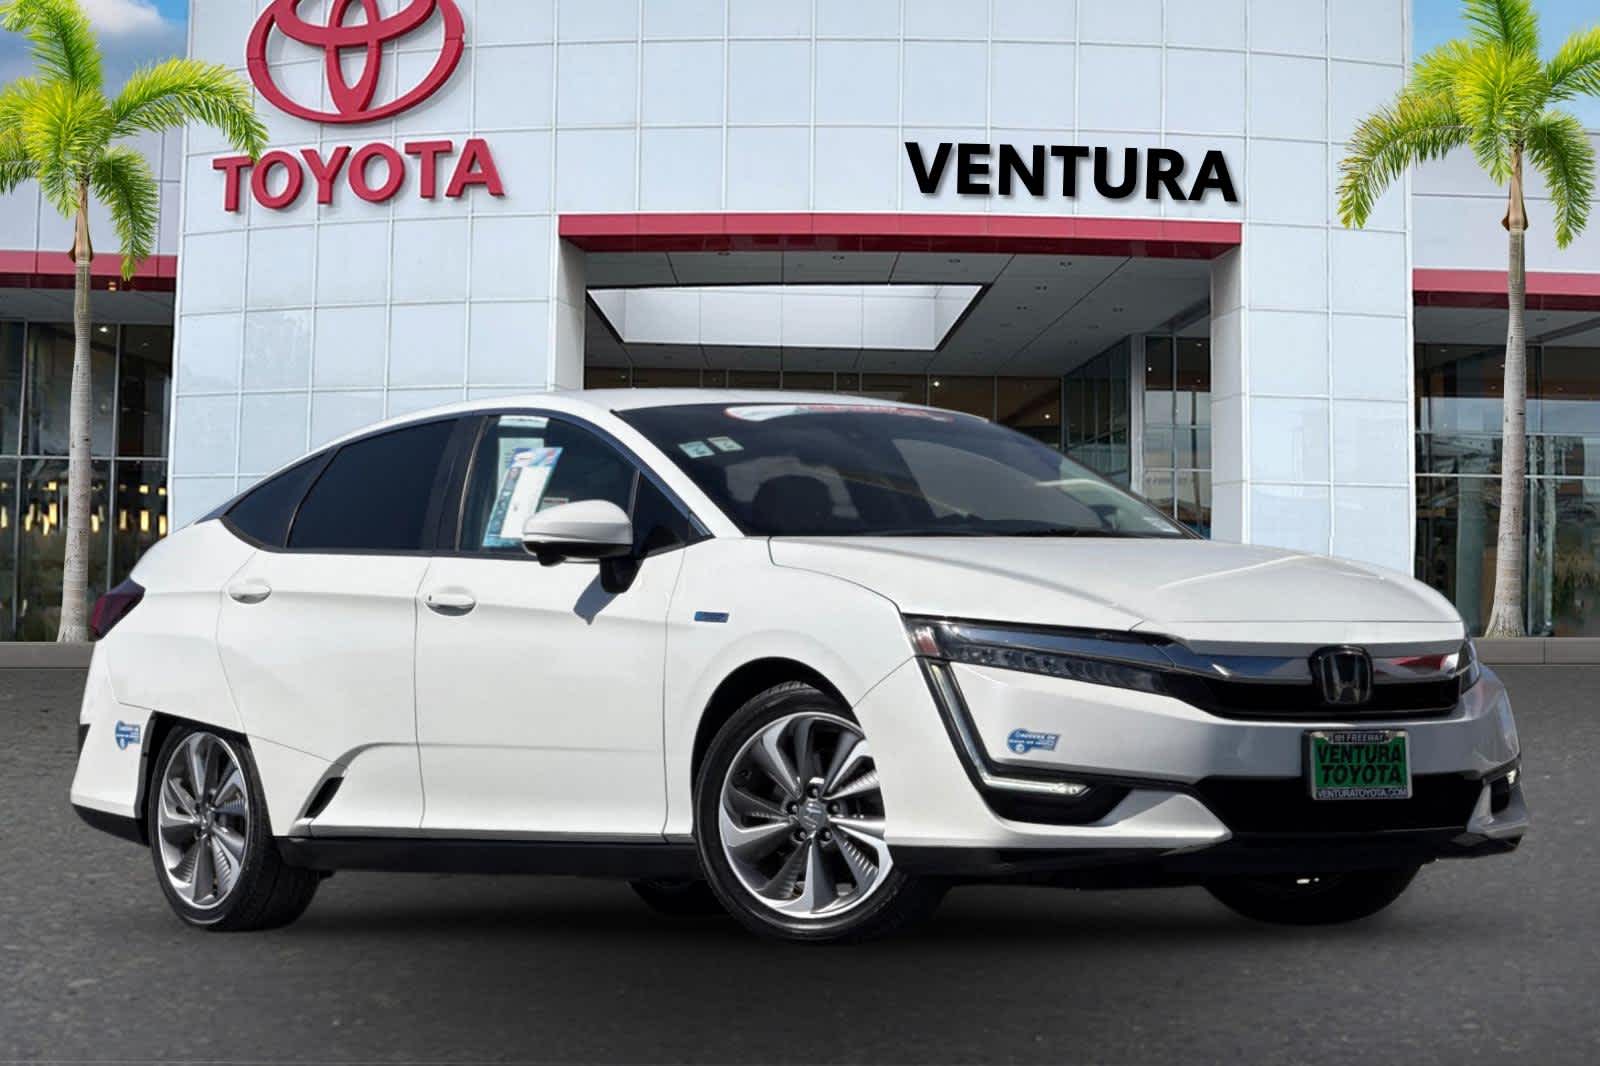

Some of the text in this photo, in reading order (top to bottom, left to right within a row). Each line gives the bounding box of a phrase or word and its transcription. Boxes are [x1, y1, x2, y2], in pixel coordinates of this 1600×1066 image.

[212, 138, 504, 212] TOYOTA
[904, 141, 1239, 202] VENTURA
[1317, 745, 1402, 763] VENTURA
[1321, 764, 1402, 784] TOYOTA
[1317, 788, 1408, 798] VENTURATOYOTA.COM
